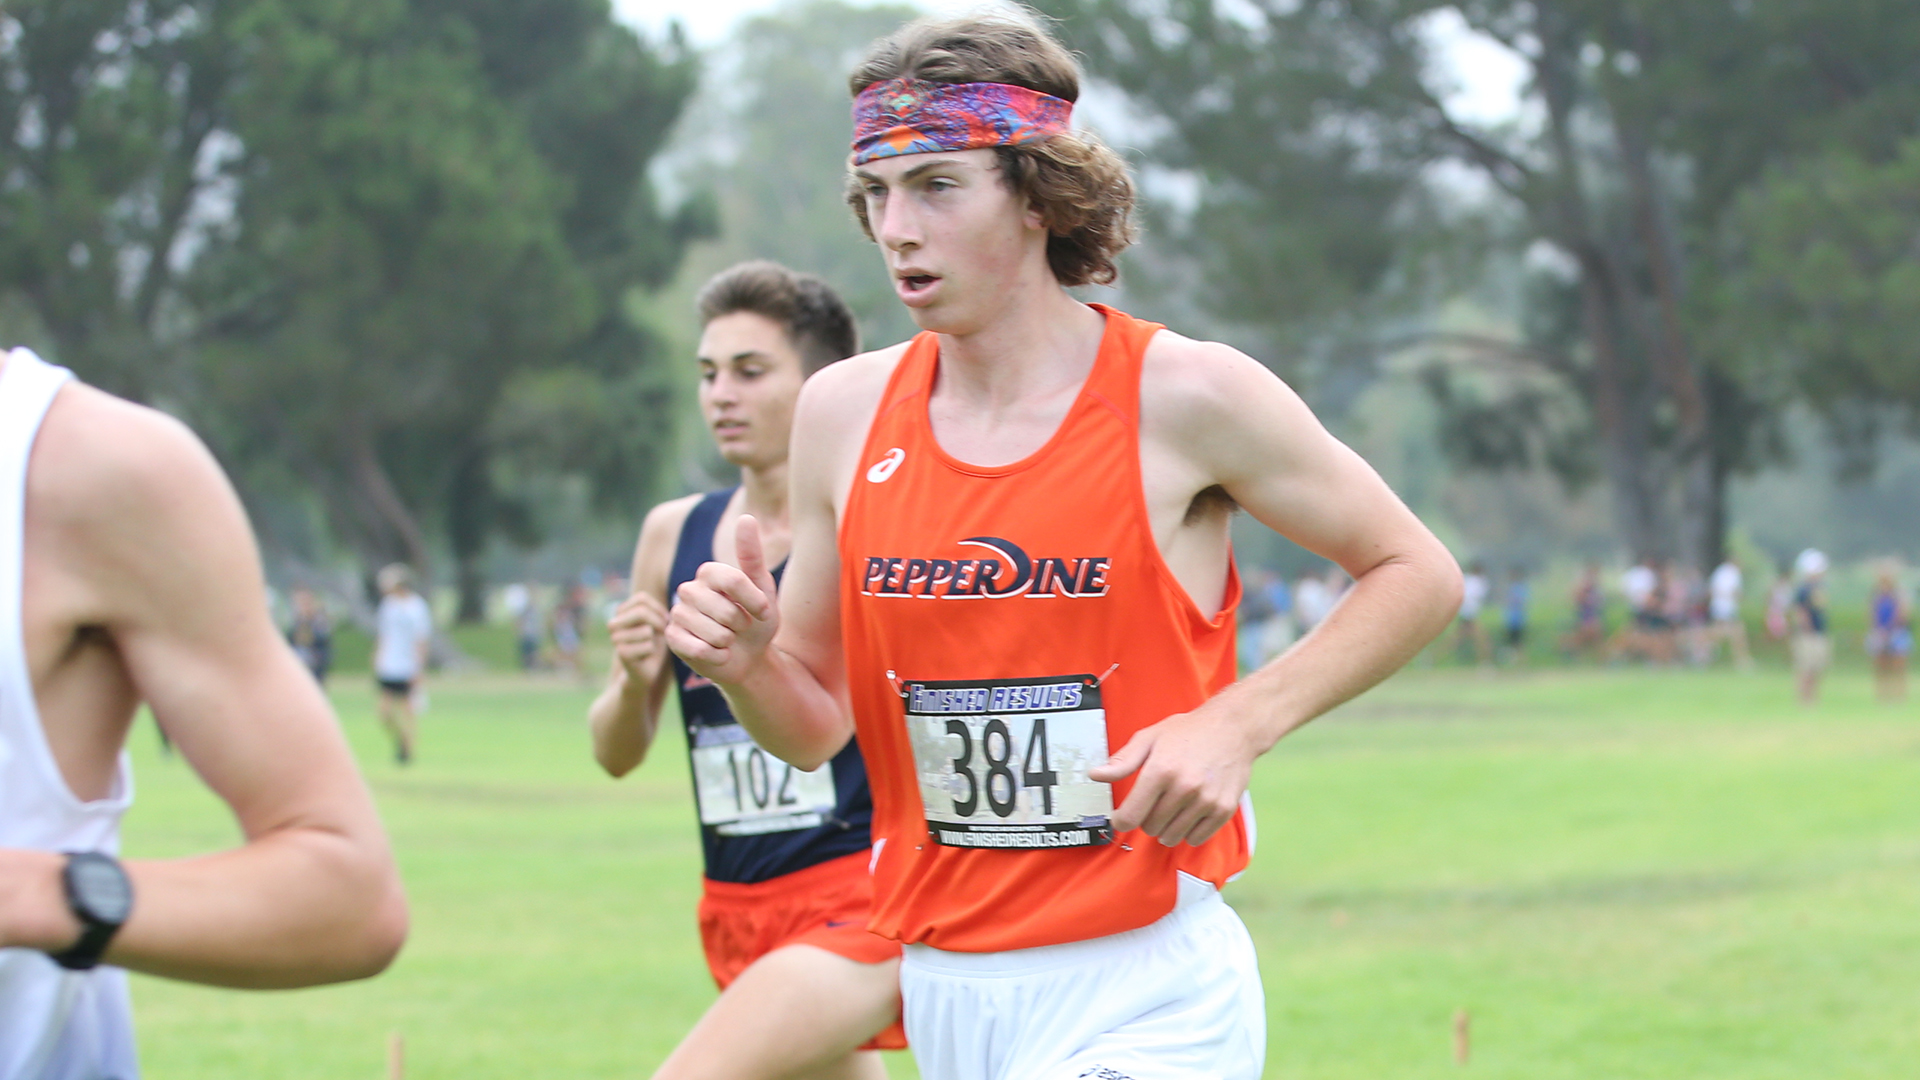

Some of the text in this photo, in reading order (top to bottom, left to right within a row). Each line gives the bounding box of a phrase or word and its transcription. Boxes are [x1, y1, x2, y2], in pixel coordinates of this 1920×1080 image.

[861, 536, 1112, 600] PEPPERDINE
[909, 682, 1083, 713] FINISHED RESULTS
[728, 747, 797, 812] 102
[946, 718, 1058, 818] 384
